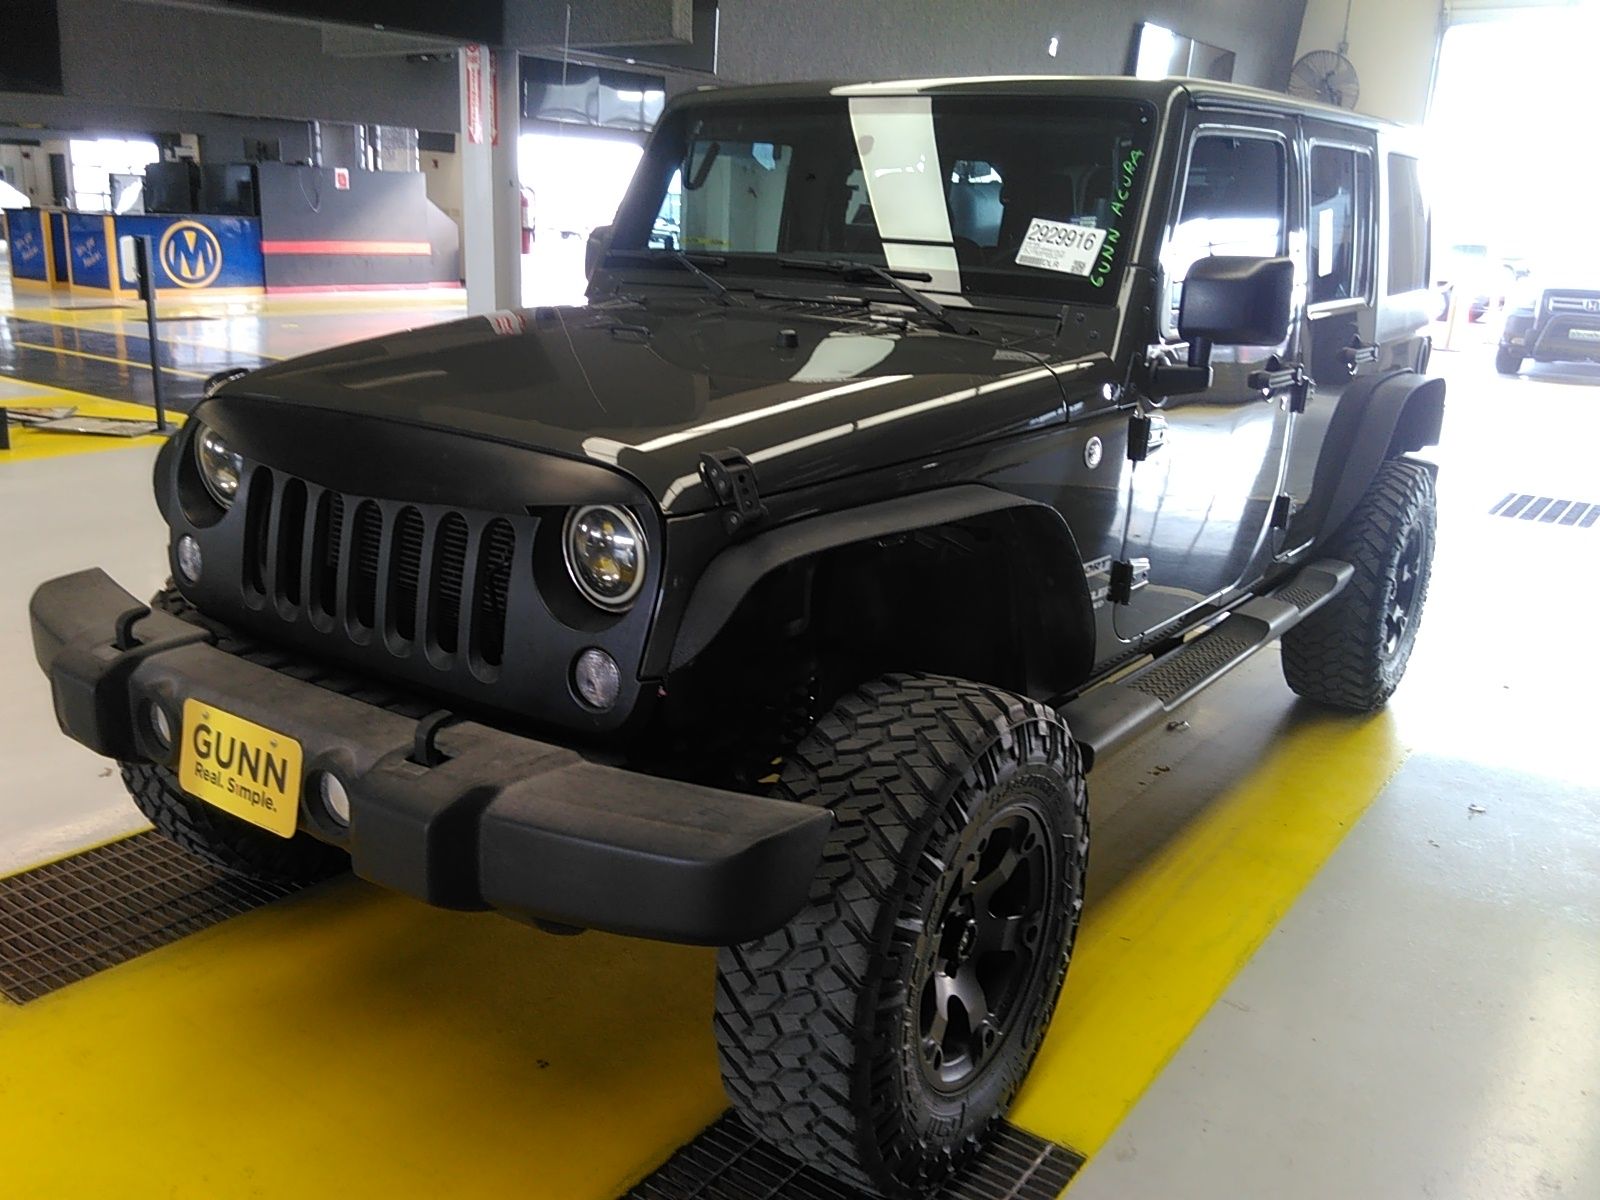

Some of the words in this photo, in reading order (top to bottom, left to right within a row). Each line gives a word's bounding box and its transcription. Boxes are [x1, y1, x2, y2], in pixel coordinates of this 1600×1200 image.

[1027, 223, 1097, 251] 2929916
[1090, 228, 1121, 288] GUNN
[1110, 149, 1145, 218] ACURA
[193, 723, 288, 795] GUNN
[195, 761, 224, 788] Real.
[227, 777, 278, 812] Simple.
